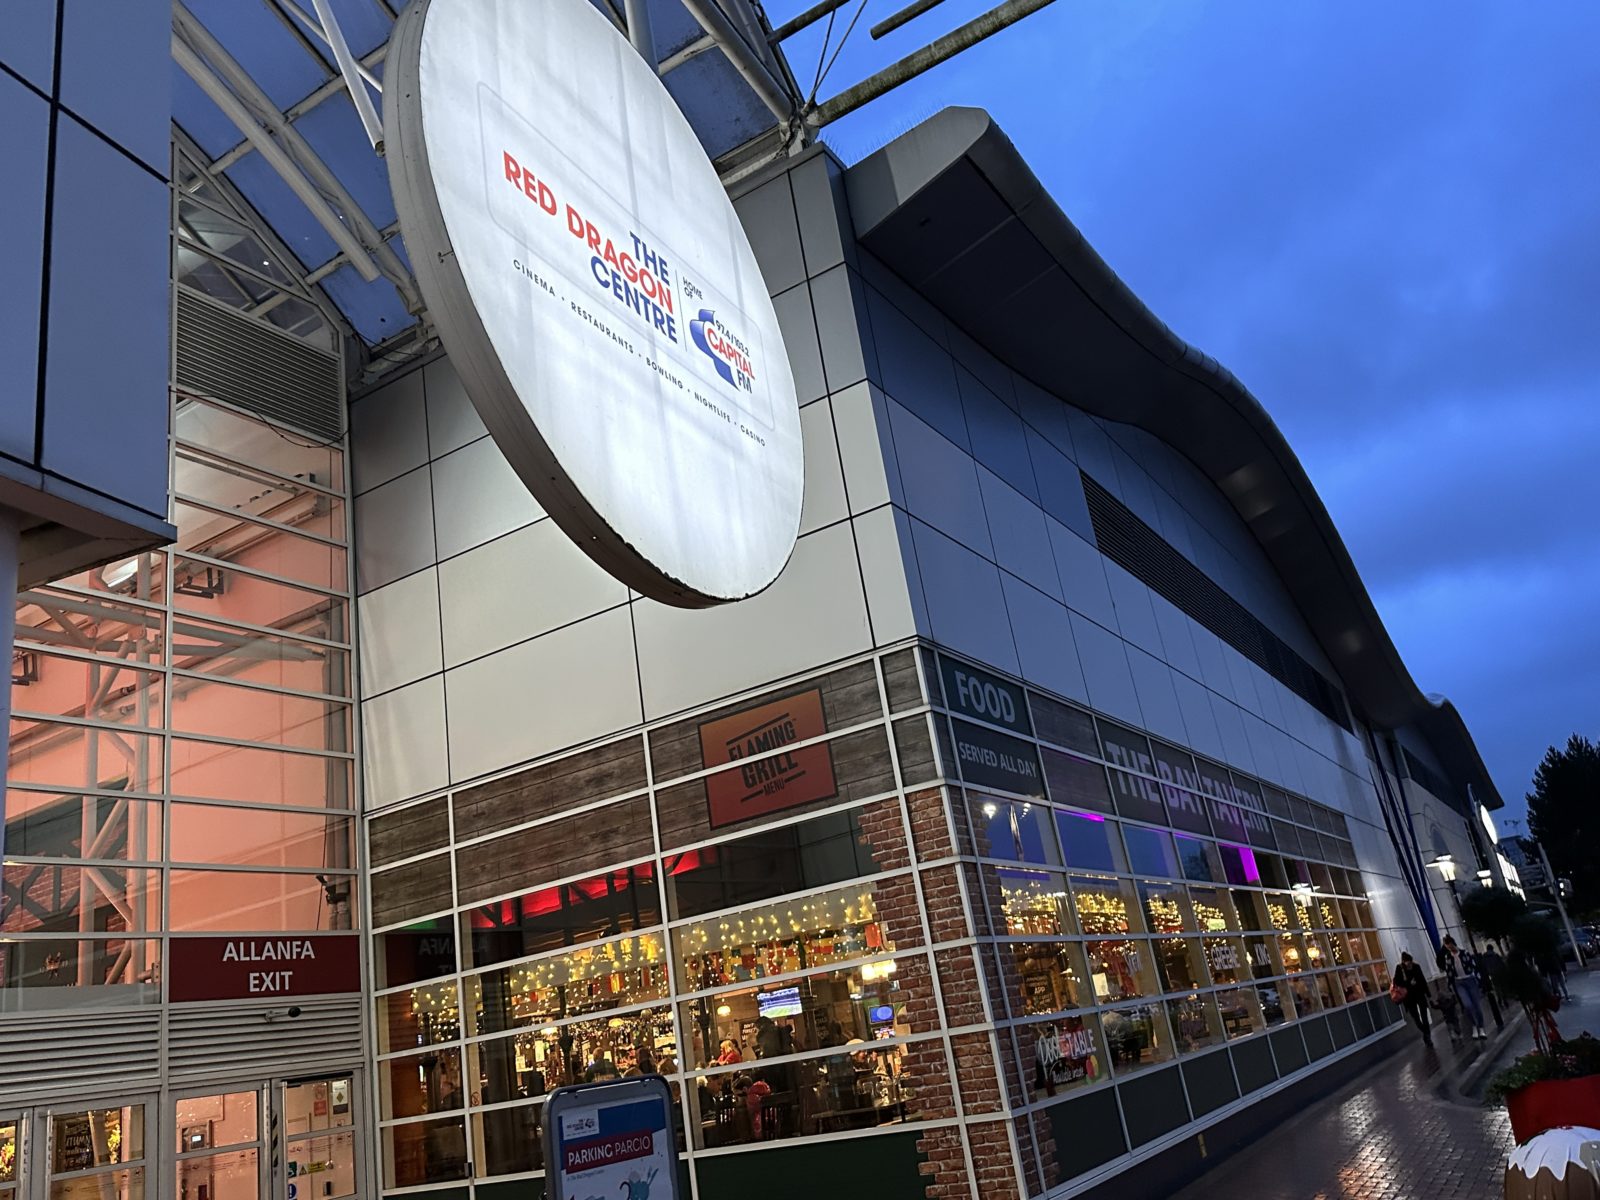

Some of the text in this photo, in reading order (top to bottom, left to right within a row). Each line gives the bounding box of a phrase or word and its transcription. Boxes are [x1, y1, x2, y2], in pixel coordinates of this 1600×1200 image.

[503, 150, 674, 315] RED DRAGON
[629, 230, 671, 287] THE
[590, 255, 678, 345] CENTRE
[682, 276, 703, 301] HOME
[684, 286, 694, 300] OF
[512, 258, 766, 447] CINEMA RESTAURANTS BOWLING NIGHTLIFE CASINO
[706, 327, 756, 381] CAPITAL
[736, 368, 753, 395] FM
[954, 670, 1016, 723] FOOD
[728, 720, 797, 762] FLAMING
[959, 742, 1037, 778] SERVED ALL DAY
[740, 751, 799, 789] GRILL
[763, 779, 786, 796] MENU
[1105, 740, 1270, 833] THE BAY TAVERN
[222, 940, 316, 962] ALLANFA
[249, 971, 293, 992] EXIT
[568, 1135, 651, 1167] PARKING PARCIO
